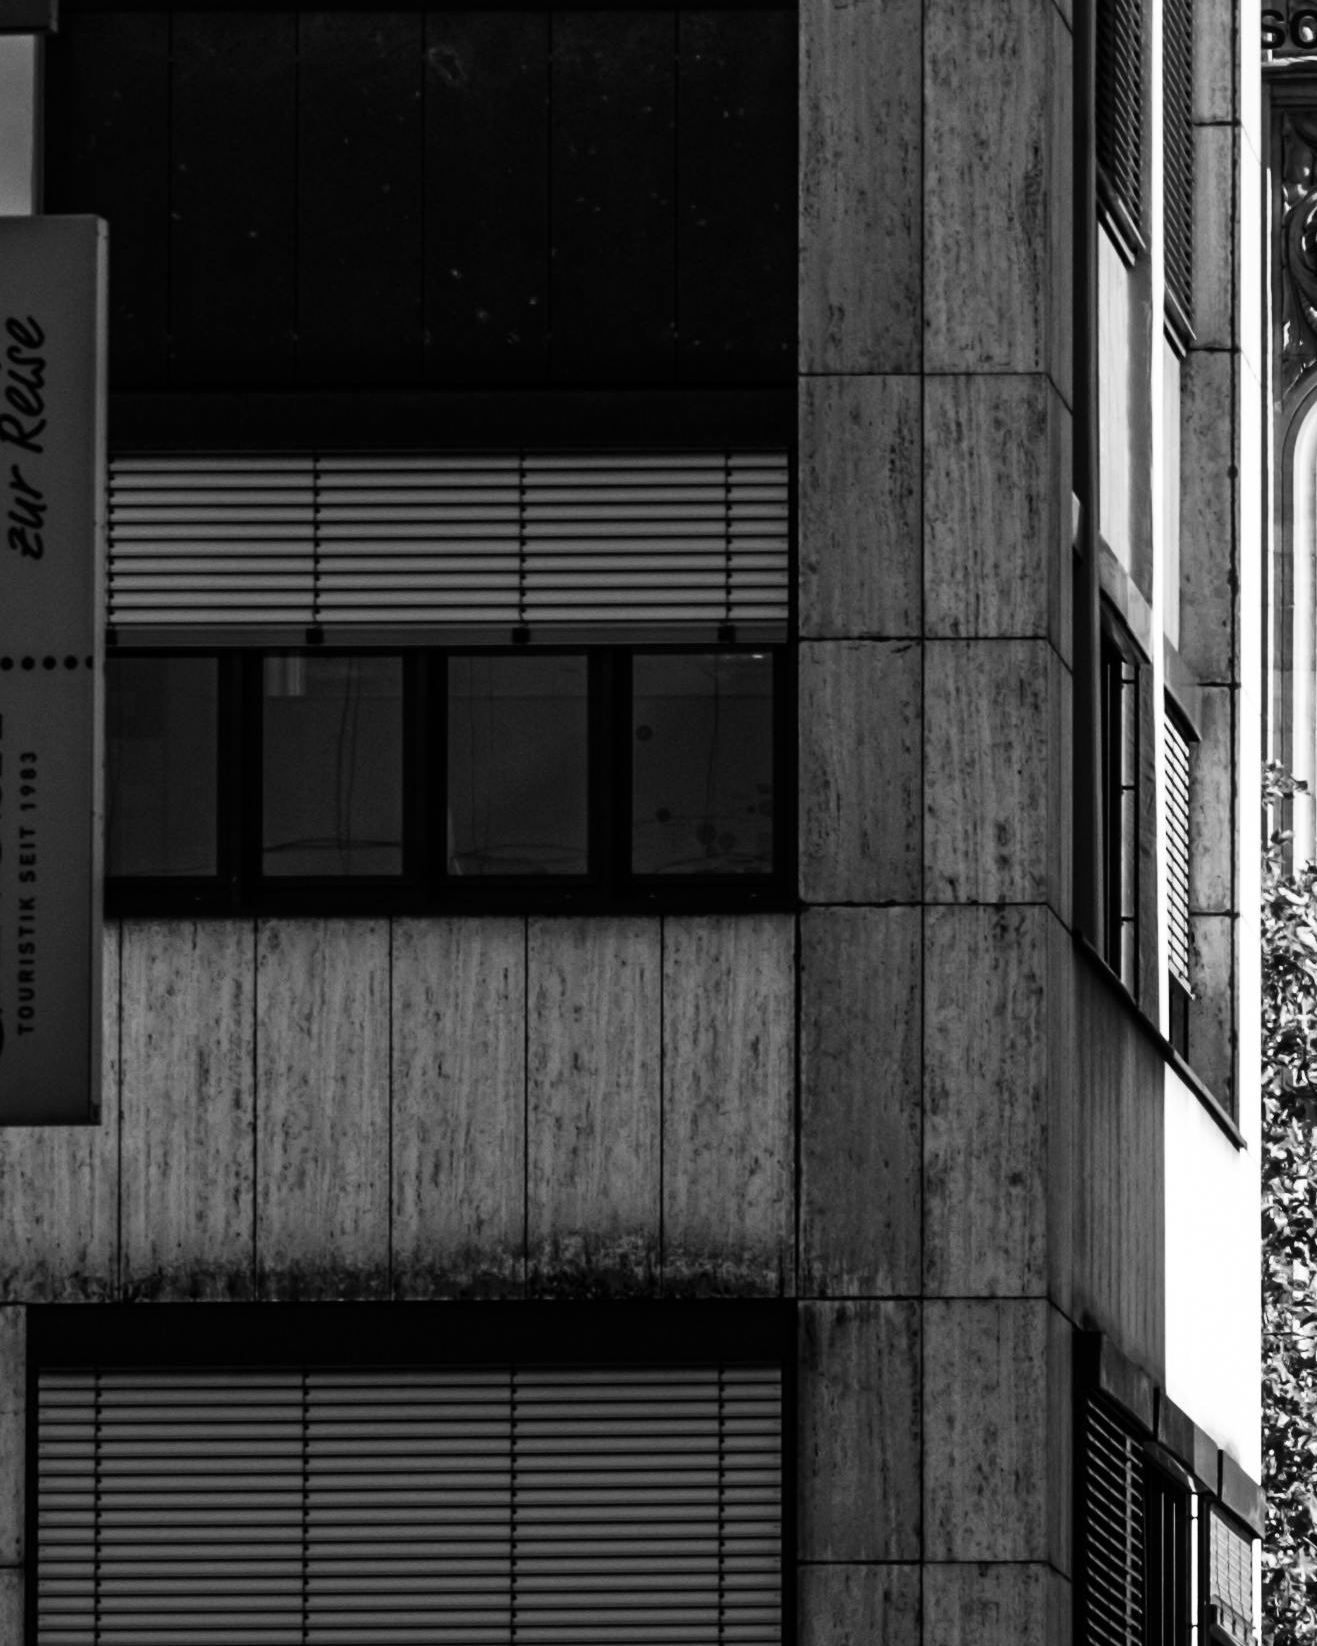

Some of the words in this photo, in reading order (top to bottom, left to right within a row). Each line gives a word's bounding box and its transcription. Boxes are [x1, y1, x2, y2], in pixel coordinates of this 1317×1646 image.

[0, 316, 46, 453] Reise
[5, 464, 46, 560] zur
[19, 751, 37, 812] 1983
[18, 825, 36, 883] SEIT
[17, 896, 36, 1036] TOURISTIK
